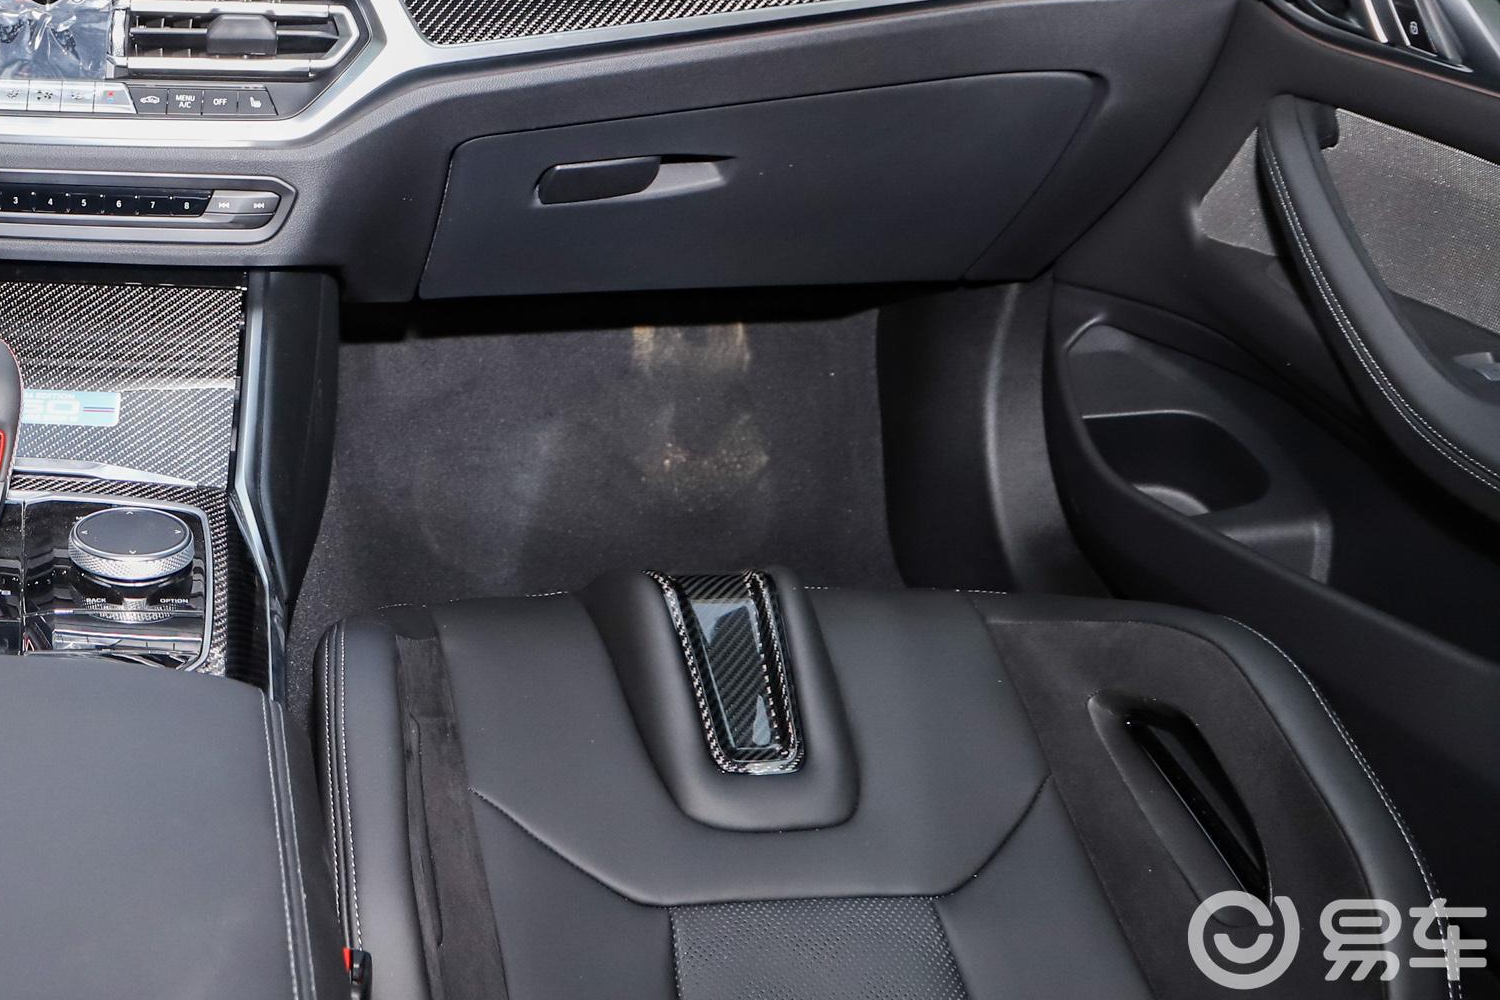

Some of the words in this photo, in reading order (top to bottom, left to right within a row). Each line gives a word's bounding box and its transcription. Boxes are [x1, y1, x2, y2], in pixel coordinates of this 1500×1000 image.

[175, 94, 196, 102] MENU
[213, 98, 228, 106] OFF
[178, 101, 192, 109] A/C
[47, 198, 54, 206] 4
[80, 199, 87, 207] 5
[115, 200, 122, 208] 6
[149, 201, 156, 209] 7
[183, 201, 191, 209] 8
